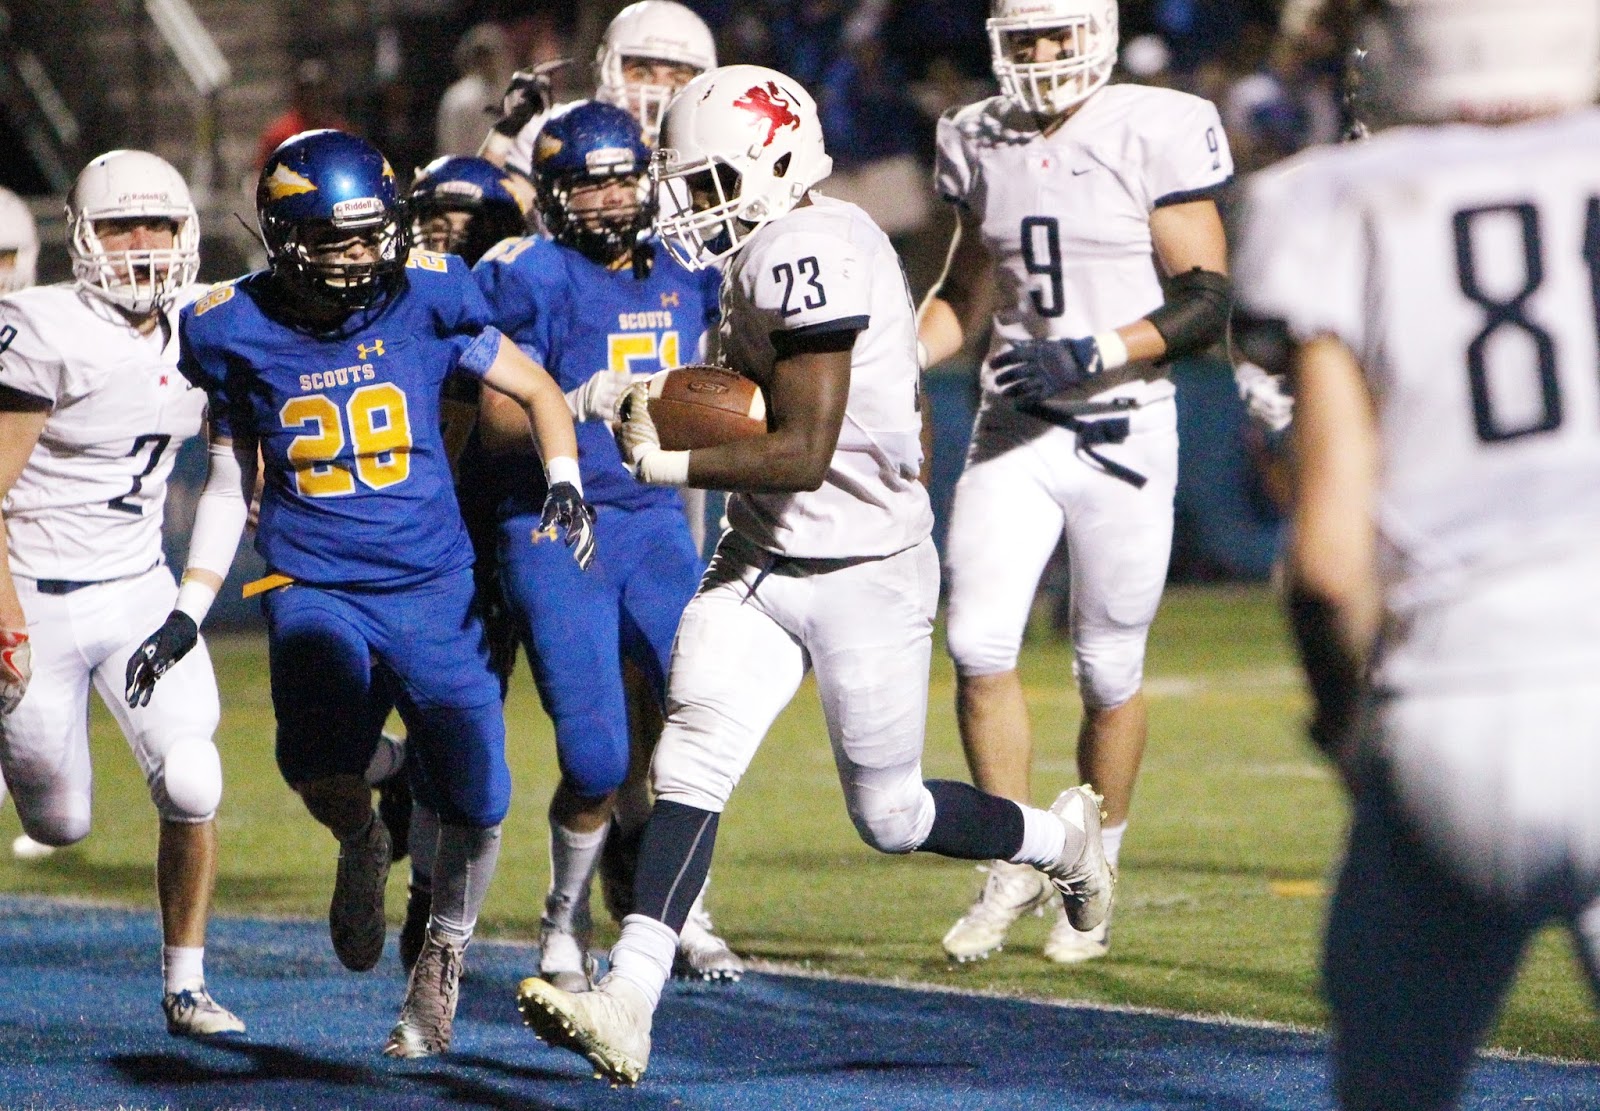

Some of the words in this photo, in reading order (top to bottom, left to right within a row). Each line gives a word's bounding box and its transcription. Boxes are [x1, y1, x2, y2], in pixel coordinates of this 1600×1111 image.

[344, 200, 372, 211] Riddell
[772, 255, 827, 318] 23
[1020, 216, 1065, 318] 9
[618, 310, 673, 331] SCOUTS
[299, 363, 375, 391] SCOUTS
[279, 381, 413, 497] 28
